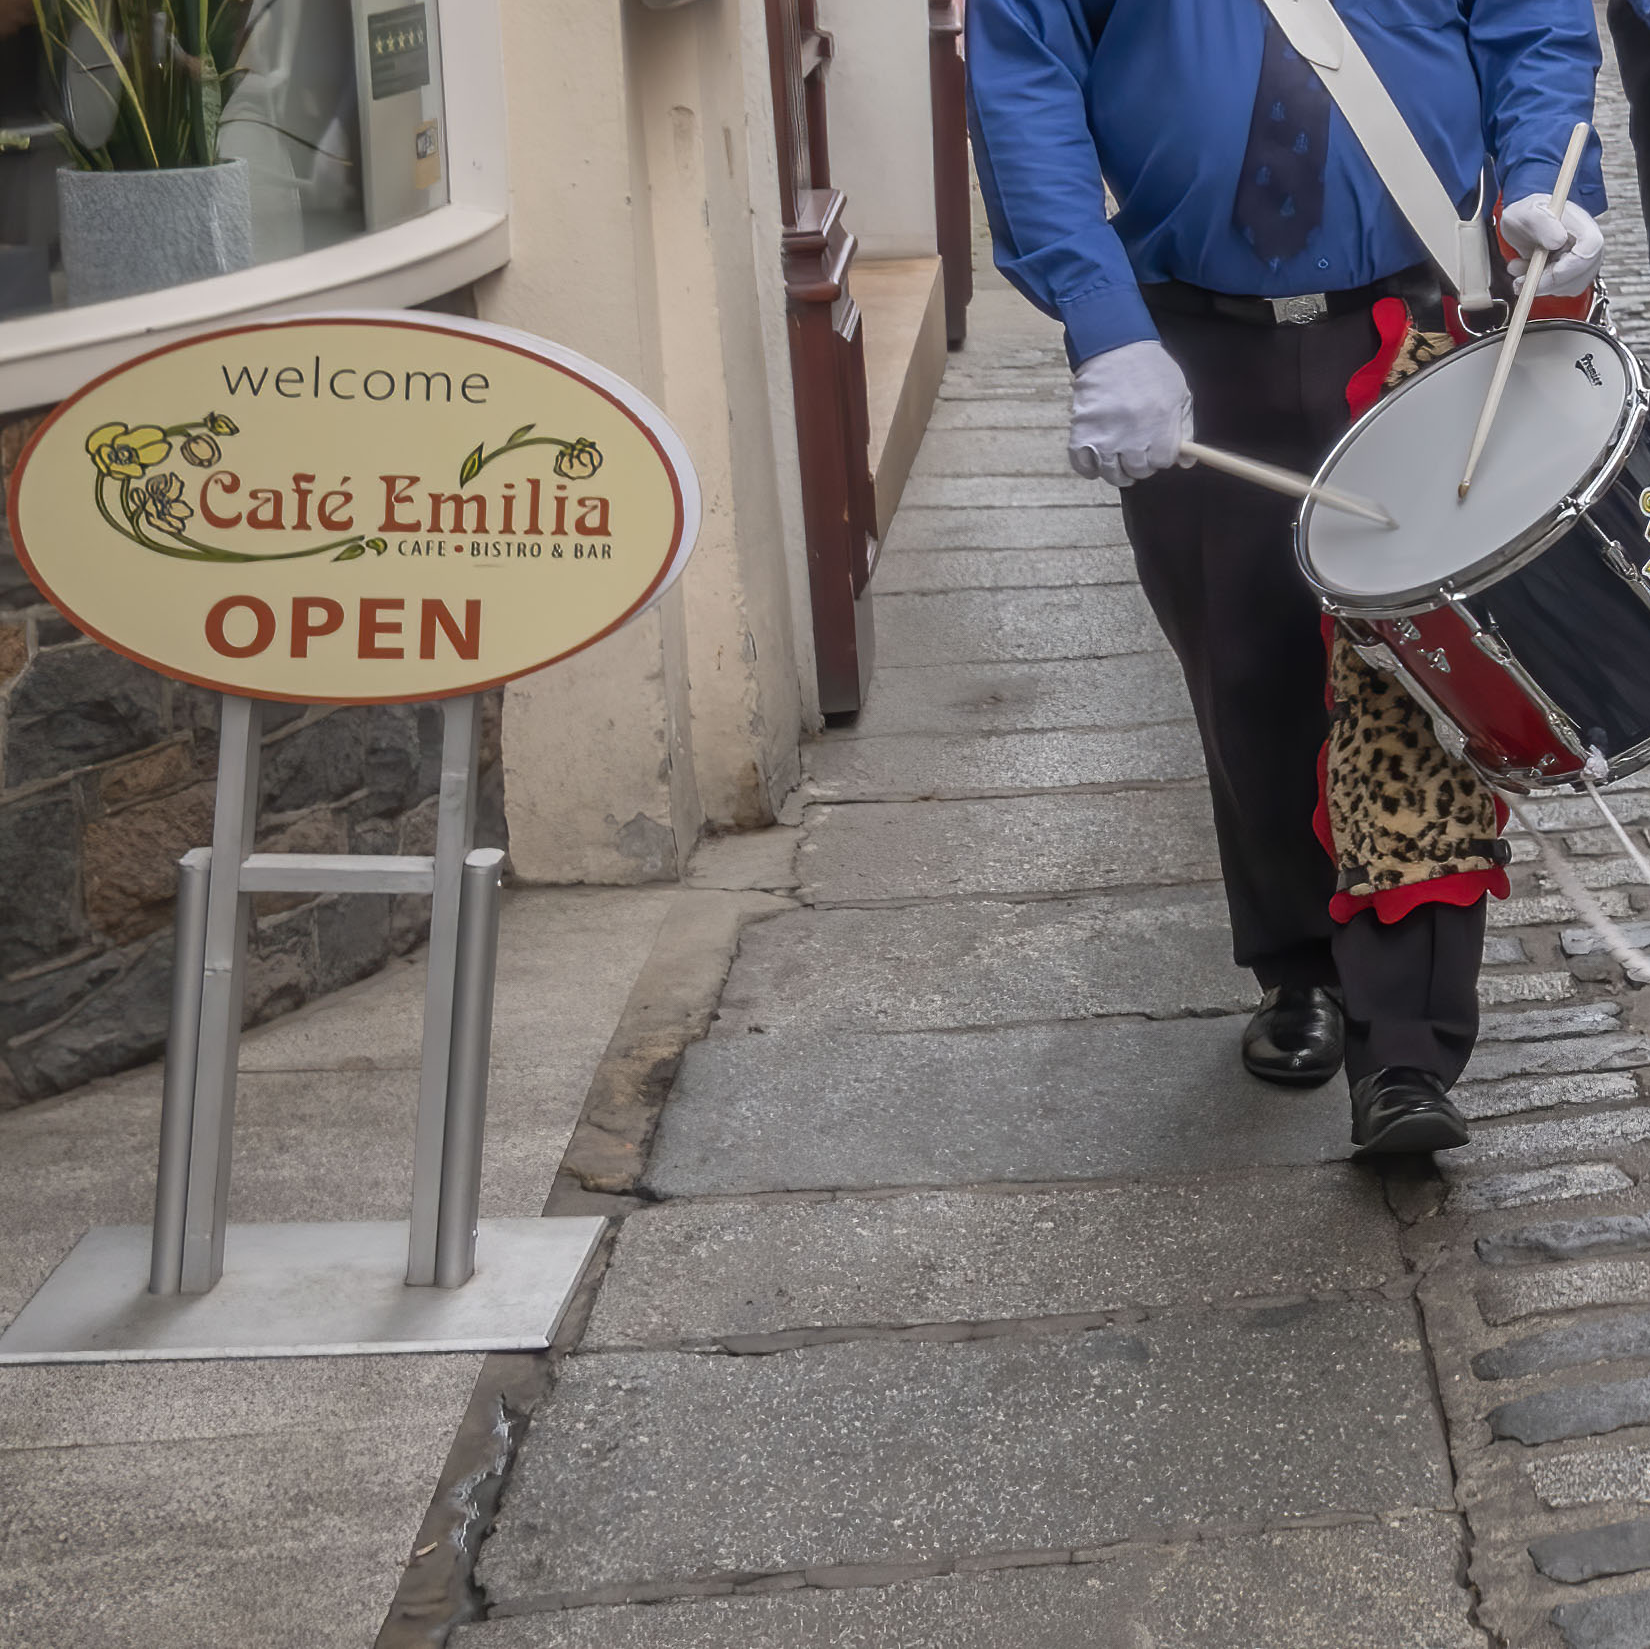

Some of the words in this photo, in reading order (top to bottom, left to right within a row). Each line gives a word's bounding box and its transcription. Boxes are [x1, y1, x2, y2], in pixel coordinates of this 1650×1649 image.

[221, 354, 490, 405] welcome
[199, 471, 356, 533] Café
[379, 474, 612, 537] Emilia
[470, 540, 542, 558] BISTRO
[551, 542, 563, 559] &
[573, 542, 612, 559] BAR
[204, 593, 482, 660] OPEN
